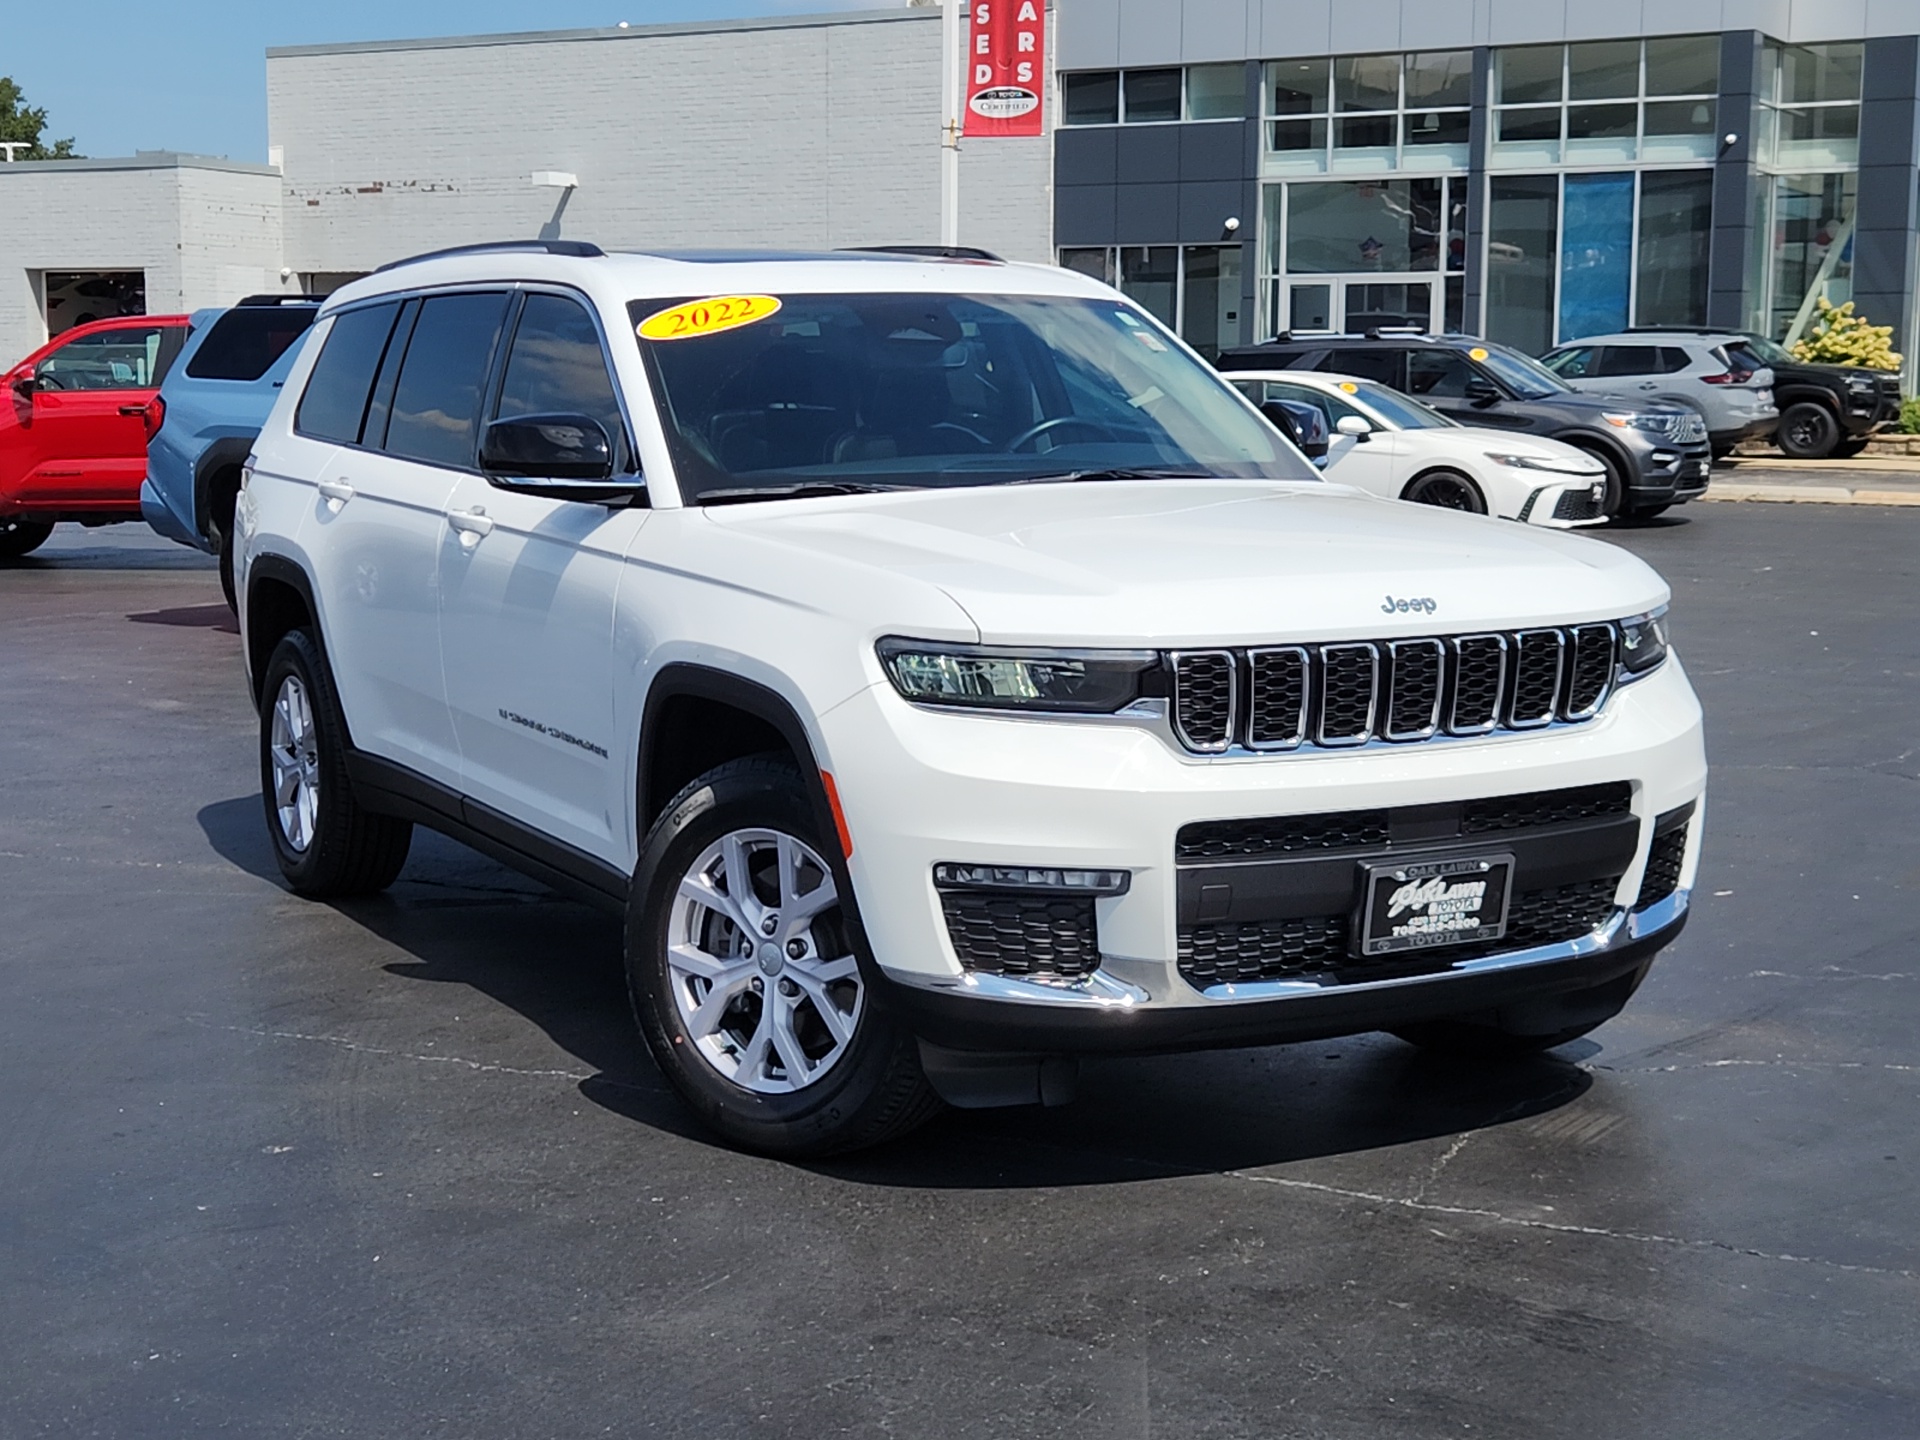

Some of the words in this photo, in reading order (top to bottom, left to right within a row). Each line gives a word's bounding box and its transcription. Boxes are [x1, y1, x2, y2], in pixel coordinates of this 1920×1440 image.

[668, 299, 755, 334] 2022
[1381, 595, 1437, 615] Jeep
[1408, 865, 1436, 877] OAK
[1440, 862, 1478, 874] LAWN
[1437, 898, 1475, 911] TOYOTA
[1408, 931, 1461, 946] TOYOTA
